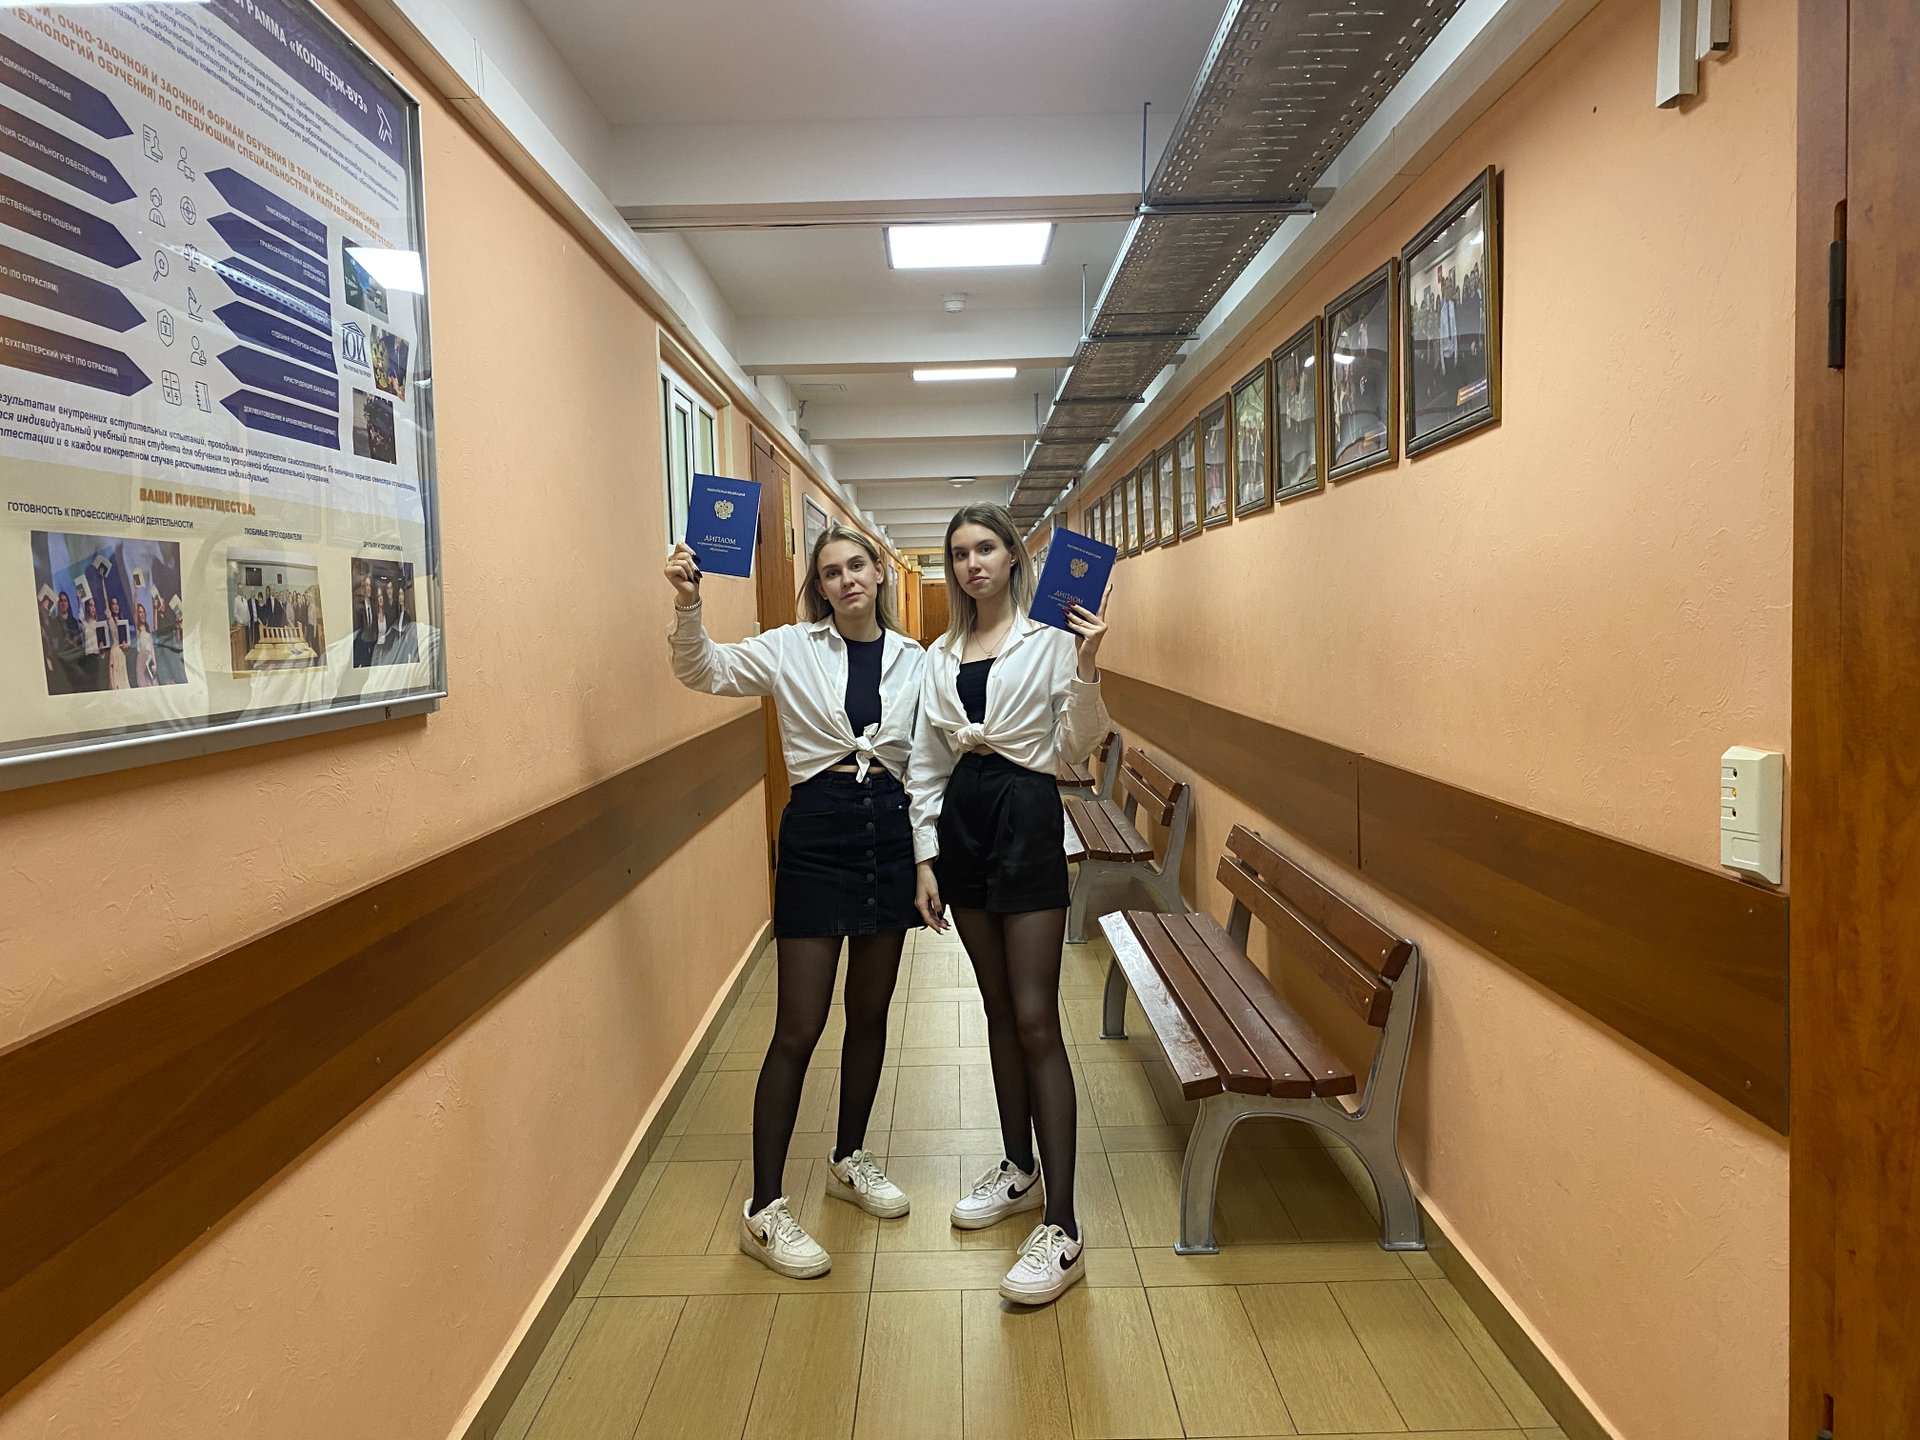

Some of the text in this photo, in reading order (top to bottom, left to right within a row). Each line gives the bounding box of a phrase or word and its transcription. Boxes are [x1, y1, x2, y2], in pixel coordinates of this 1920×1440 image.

[111, 5, 139, 29] лизма,
[141, 18, 175, 52] овладеть
[176, 43, 198, 67] иными
[147, 8, 193, 53] Юридический
[194, 43, 226, 75] институт
[0, 52, 71, 102] АДМИНИСТРИРОВАНИЕ
[290, 36, 367, 115] «КОЛЛЕДЖ-ВУЗ»
[58, 7, 148, 82] ОЧНО-ЗАОЧНОЙ
[151, 71, 157, 85] И
[160, 76, 204, 116] ЗАОЧНОЙ
[207, 107, 244, 141] ФОРМАМ
[246, 132, 286, 168] ОБУЧЕНИЯ
[296, 166, 311, 184] ТОМ
[312, 176, 334, 199] ЧИСЛЕ
[335, 191, 339, 202] С
[98, 53, 155, 103] ОБУЧЕНИЯ)
[158, 93, 171, 112] ПО
[174, 102, 235, 153] СЛЕДУЮЩИМ
[237, 141, 308, 197] СПЕЦИАЛЬНОСТЯМ
[310, 188, 314, 199] И
[17, 132, 64, 164] СОЦИАЛЬНОГО
[65, 156, 107, 185] ОБЕСПЕЧЕНИЯ
[43, 212, 80, 236] ОТНОШЕНИЯ
[22, 272, 58, 294] ОТРАСЛЯМ)
[5, 335, 58, 360] БУХГАЛТЕРСКИЙ
[59, 351, 74, 364] УЧЁТ
[75, 356, 85, 368] (ПО
[87, 360, 118, 377] ОТРАСЛЯМ)
[17, 410, 91, 438] индивидуальный
[93, 426, 126, 445] учебный
[128, 434, 145, 447] план
[147, 438, 180, 455] студента
[182, 446, 192, 456] для
[194, 448, 221, 463] обучения
[222, 455, 230, 464] по
[231, 456, 261, 471] ускоренной
[262, 462, 304, 480] образовательной
[59, 404, 106, 426] внутренних
[110, 415, 167, 439] вступительных
[169, 429, 206, 447] испытаний,
[207, 438, 243, 455] проводимых
[245, 446, 286, 464] университетом
[56, 436, 61, 445] и
[64, 438, 68, 447] в
[71, 437, 101, 453] каждом
[103, 445, 148, 464] конкретном
[150, 454, 173, 468] случае
[174, 458, 226, 477] рассчитывается
[228, 468, 269, 485] индивидуально.
[8, 501, 193, 530] ГОТОВНОСТЬ К ПРОФЕССИОНАЛЬНОЙ ДЕЯТЕЛЬНОСТИ
[139, 487, 172, 505] ВАШИ
[244, 527, 302, 541] ЛЮБИМЫЕ ПРЕПОДАВАТЕЛИ
[703, 534, 736, 545] ДИПЛОМ
